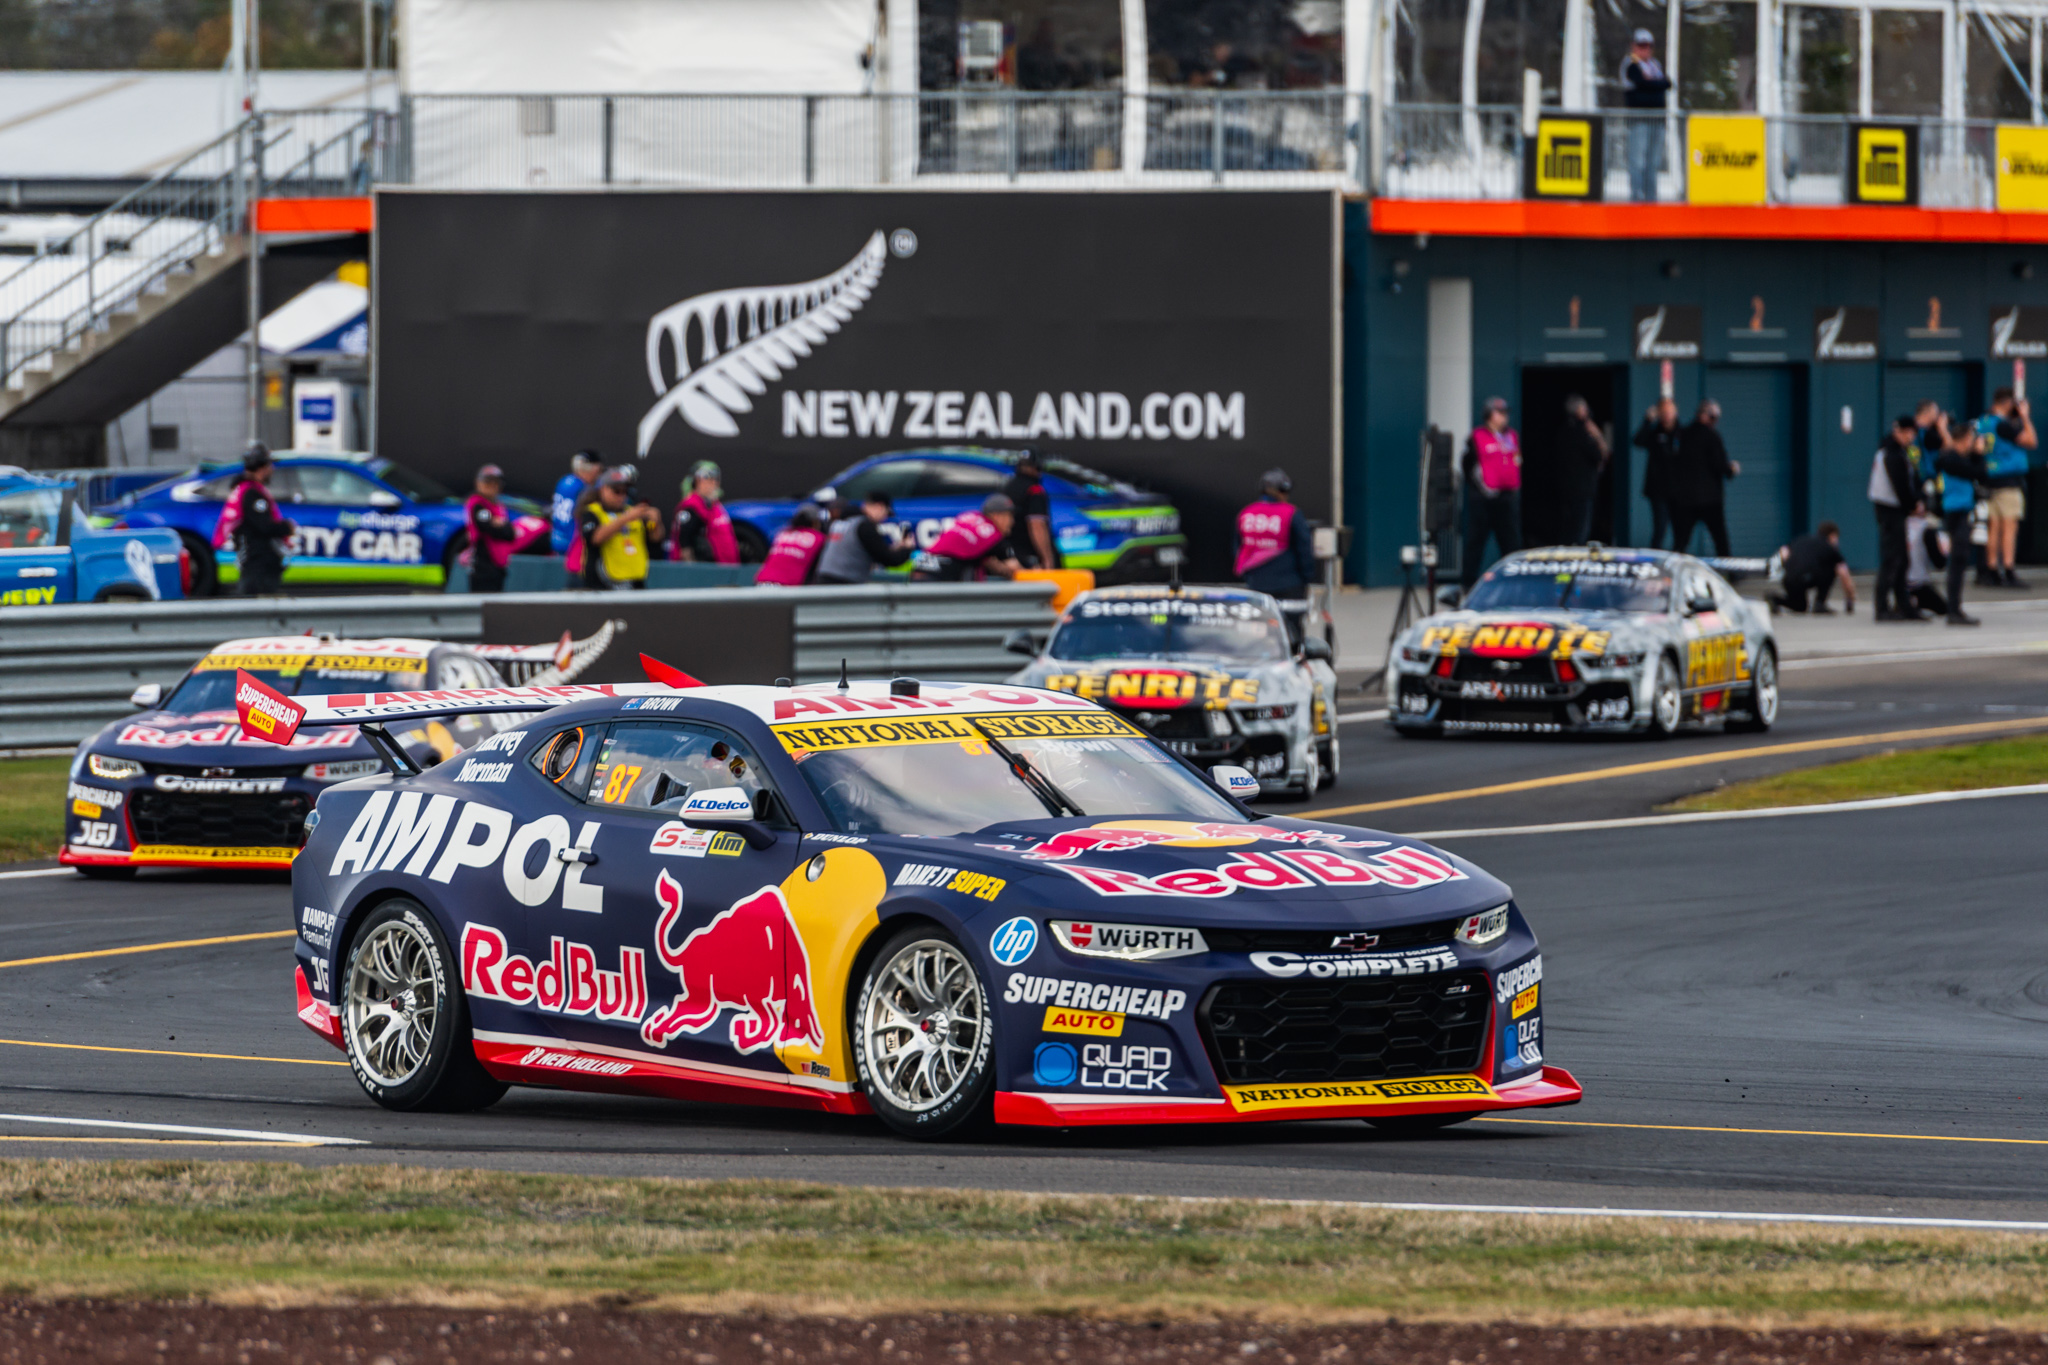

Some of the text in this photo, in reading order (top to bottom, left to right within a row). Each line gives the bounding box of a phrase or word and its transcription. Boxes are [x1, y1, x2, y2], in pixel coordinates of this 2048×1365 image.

[351, 530, 422, 563] CAR
[1081, 600, 1227, 617] Steadfast
[1421, 625, 1612, 657] PENRITE
[312, 656, 420, 671] STORAGE
[374, 683, 620, 706] AMPLIFY
[1045, 673, 1260, 703] PENRITE
[237, 682, 299, 728] SUPERCHEAP
[640, 697, 684, 712] BROWN
[251, 712, 273, 730] AUTO
[776, 713, 1131, 751] NATIONAL STORAGE
[958, 739, 991, 756] 87
[453, 758, 515, 783] Norman
[603, 763, 643, 804] 87
[687, 799, 750, 810] ACDelco
[811, 833, 868, 845] DUNLOP
[328, 790, 605, 914] AMPOL
[893, 863, 942, 886] MAKE
[946, 870, 1007, 902] SUPER
[996, 917, 1030, 964] hp
[1249, 951, 1459, 978] COMPLETE
[1003, 972, 1187, 1020] SUPERCHEAP
[1514, 990, 1536, 1012] AUTO
[1051, 1013, 1116, 1031] AUTO
[539, 1052, 634, 1076] NEW HOLLAND
[811, 1061, 831, 1078] Repco
[1082, 1043, 1172, 1071] QUAD
[1080, 1067, 1170, 1092] LOCK
[1236, 1078, 1484, 1105] NATIONAL STORAGE
